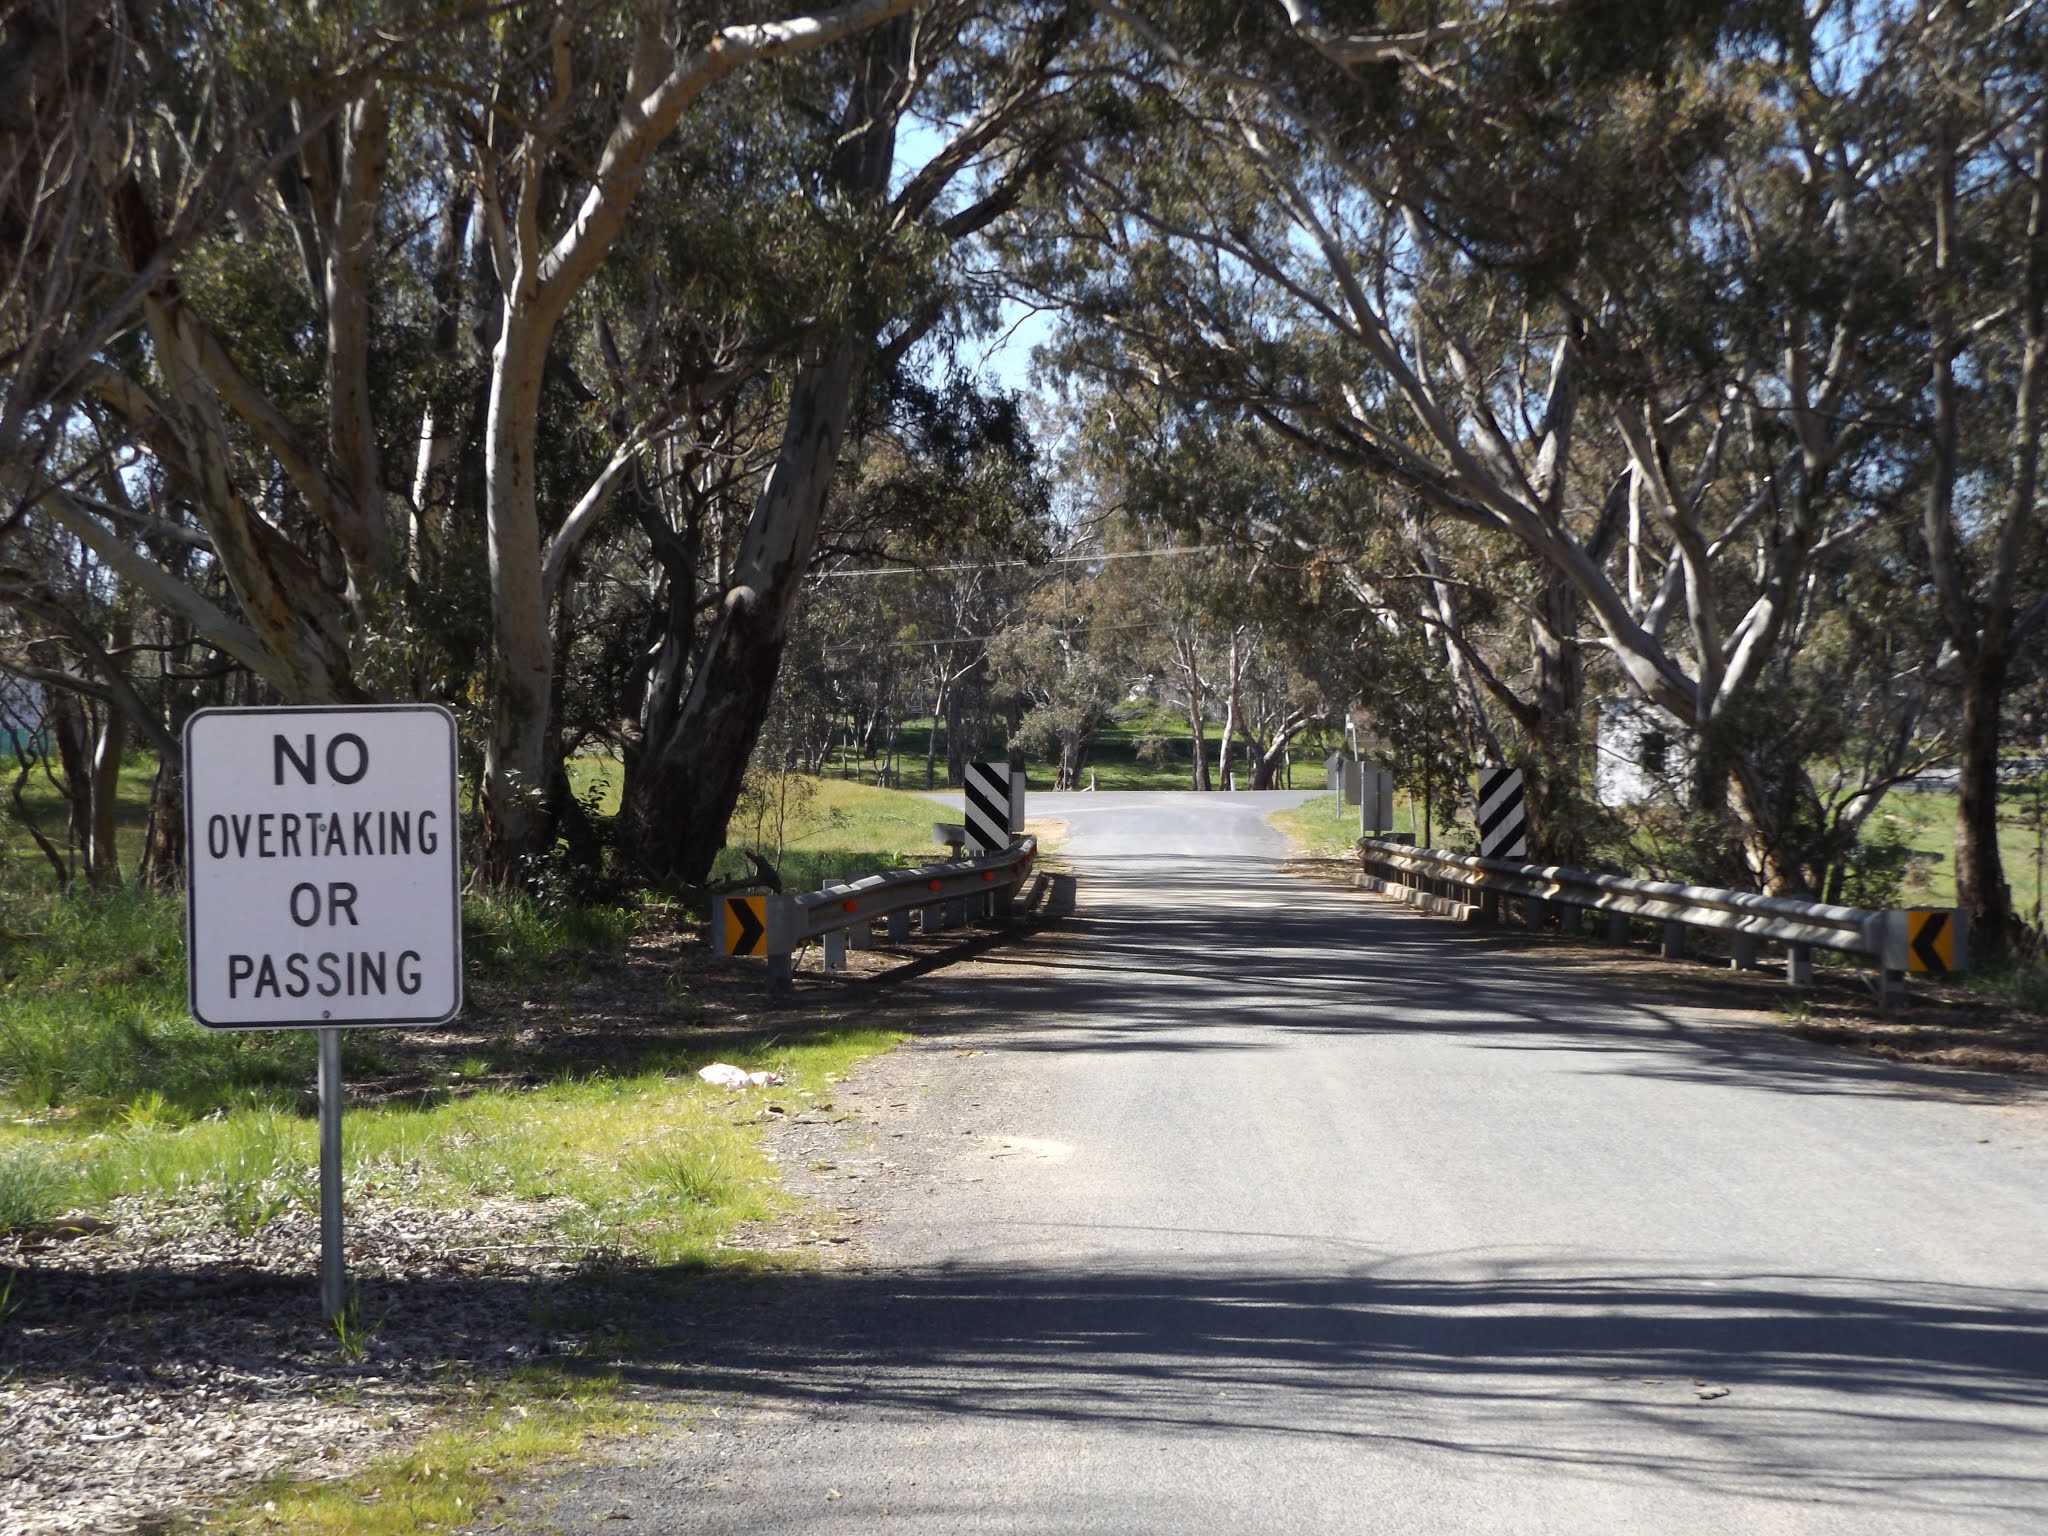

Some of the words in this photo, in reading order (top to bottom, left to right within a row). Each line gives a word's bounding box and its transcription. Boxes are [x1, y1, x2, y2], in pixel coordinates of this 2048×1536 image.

[273, 732, 370, 786] NO
[207, 809, 439, 860] OVERTAKING
[289, 881, 360, 928] OR
[228, 949, 423, 1000] PASSING
